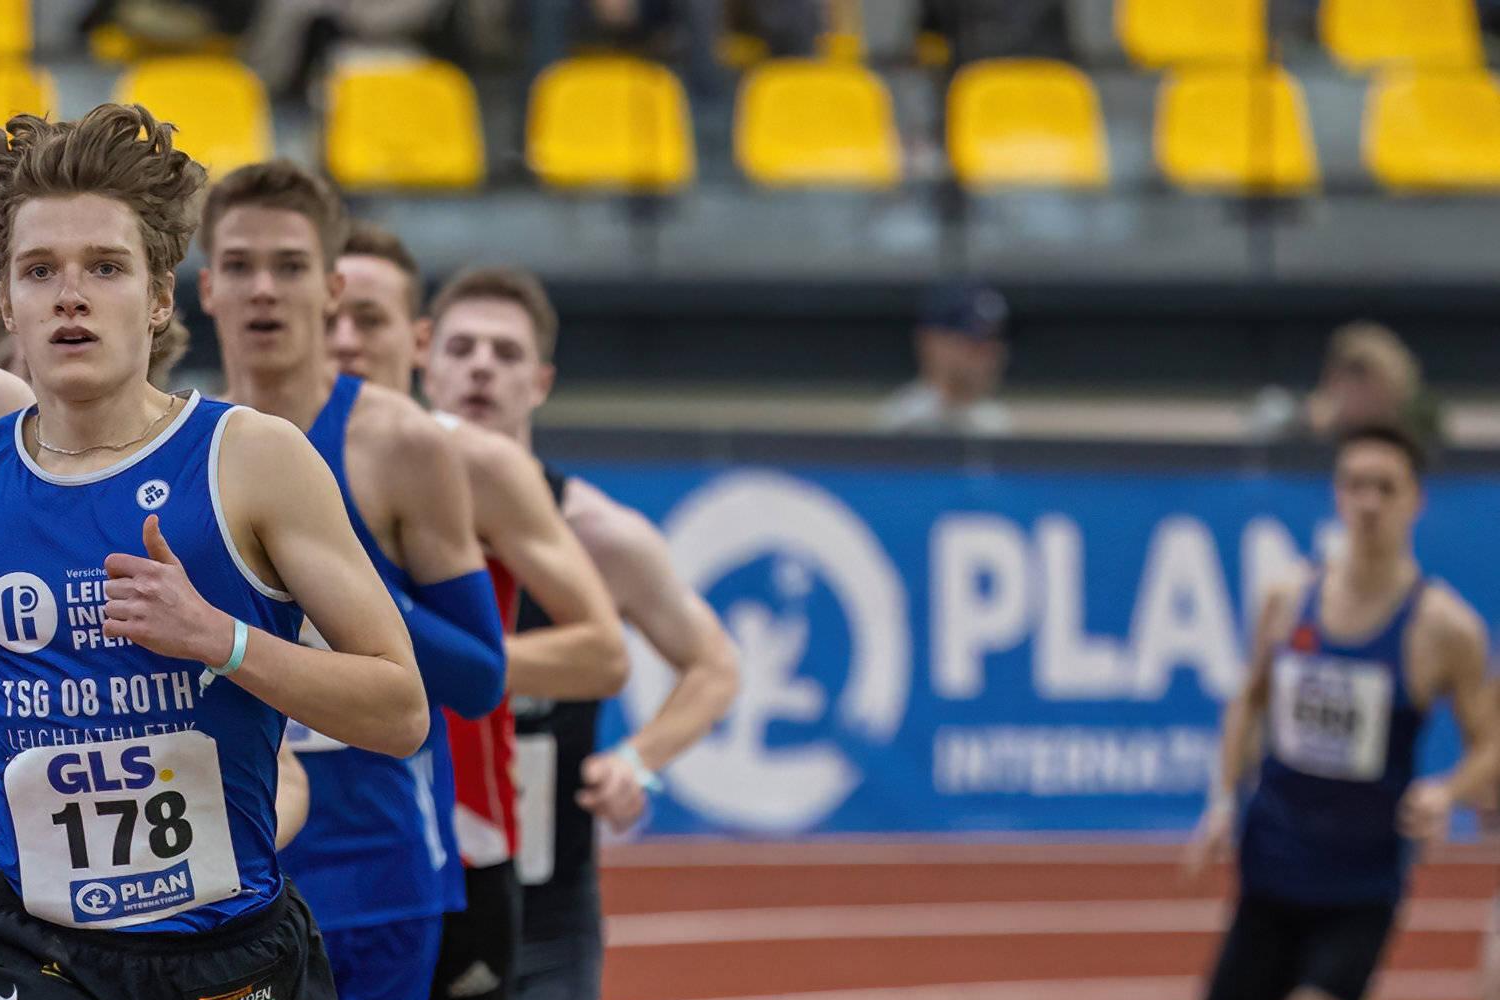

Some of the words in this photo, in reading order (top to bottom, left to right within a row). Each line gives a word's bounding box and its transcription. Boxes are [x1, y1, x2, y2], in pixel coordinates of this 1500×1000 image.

[66, 567, 108, 579] Versiche
[2, 679, 50, 718] TSG
[60, 678, 100, 717] 08
[110, 671, 194, 715] ROTH
[51, 790, 193, 869] 178
[119, 871, 188, 902] PLAN
[124, 892, 189, 912] INTERNATIONAL
